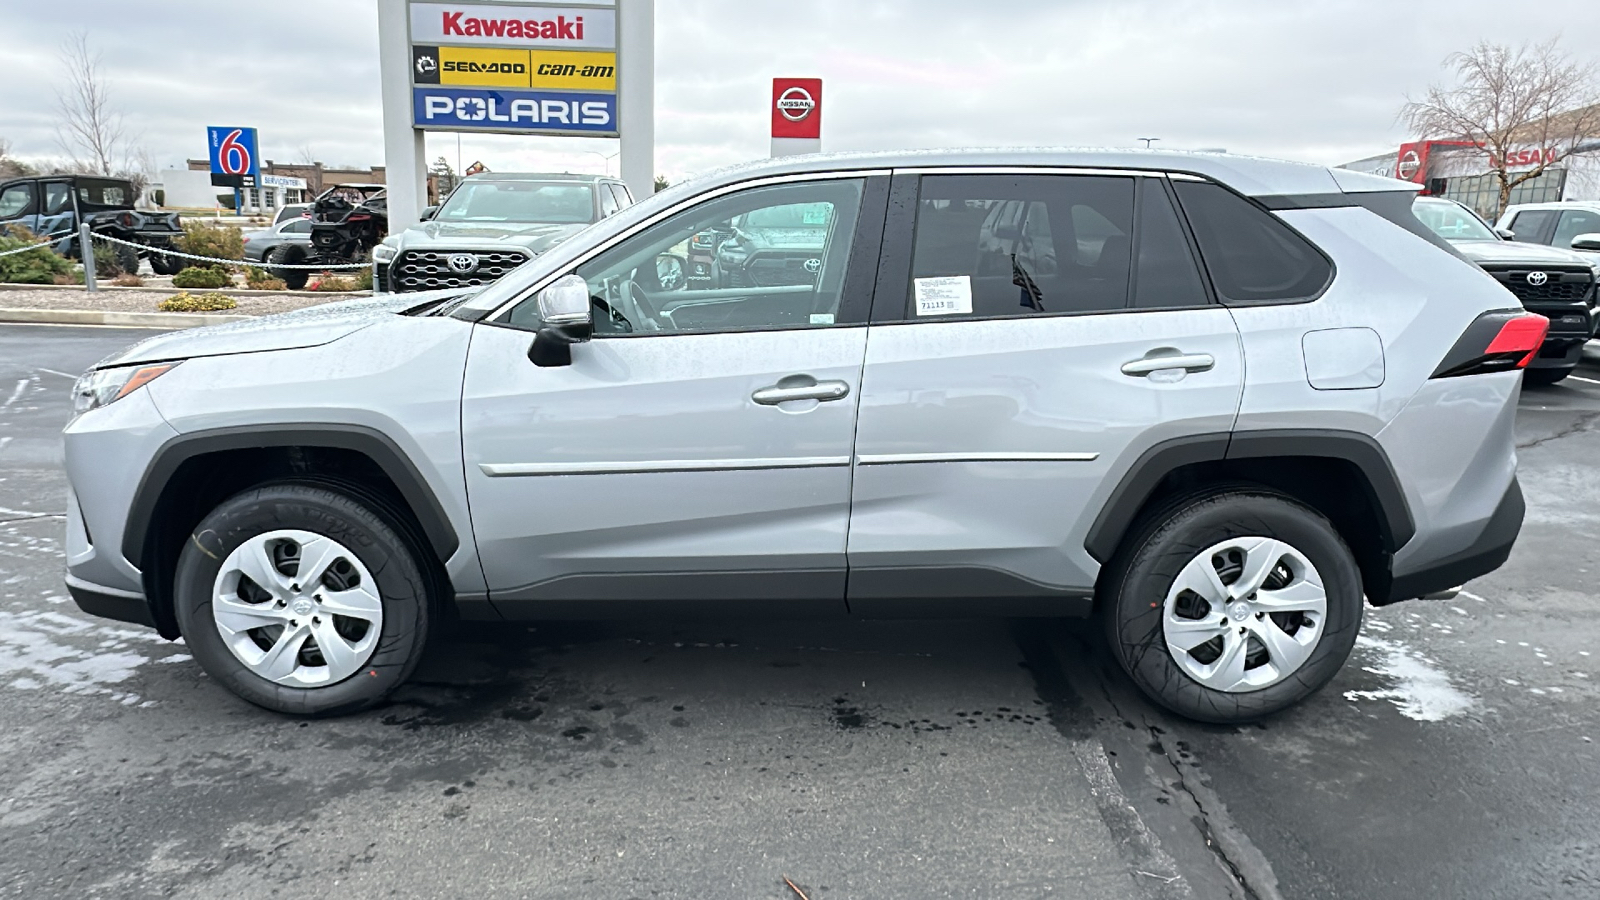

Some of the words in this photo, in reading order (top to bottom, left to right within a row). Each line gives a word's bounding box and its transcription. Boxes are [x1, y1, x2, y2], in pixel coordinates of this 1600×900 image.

[442, 11, 584, 40] Kawasaki
[424, 96, 610, 125] POLARIS
[219, 129, 250, 174] 6
[1490, 147, 1555, 167] NSSAN
